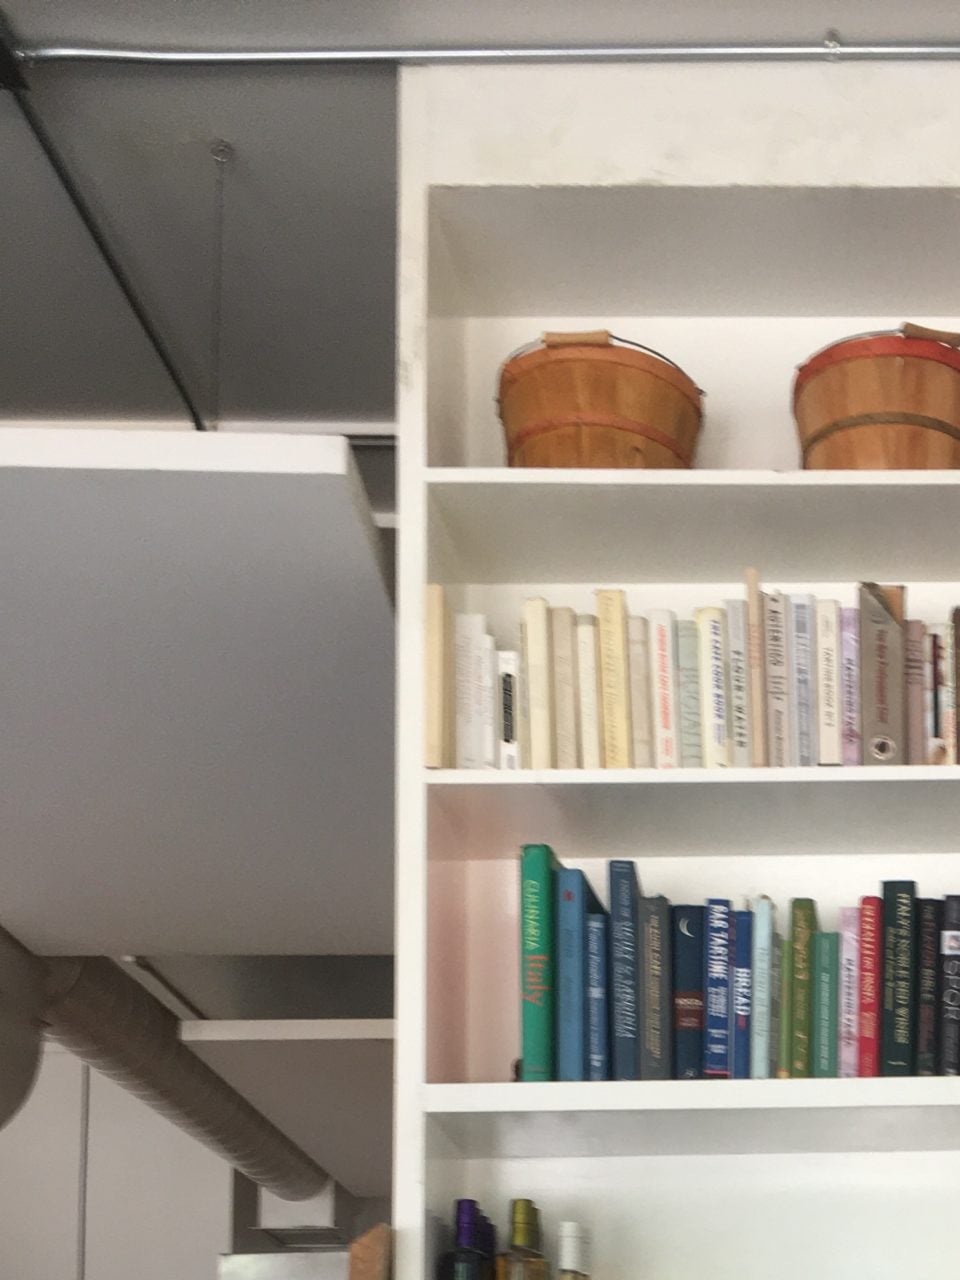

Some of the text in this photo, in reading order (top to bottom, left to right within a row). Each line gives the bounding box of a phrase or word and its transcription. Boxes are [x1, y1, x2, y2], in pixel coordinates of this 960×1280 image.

[709, 905, 729, 928] BAR
[521, 880, 550, 1005] CULINARIA Italy
[709, 931, 729, 980] TARTINE
[733, 968, 751, 1016] BREAD
